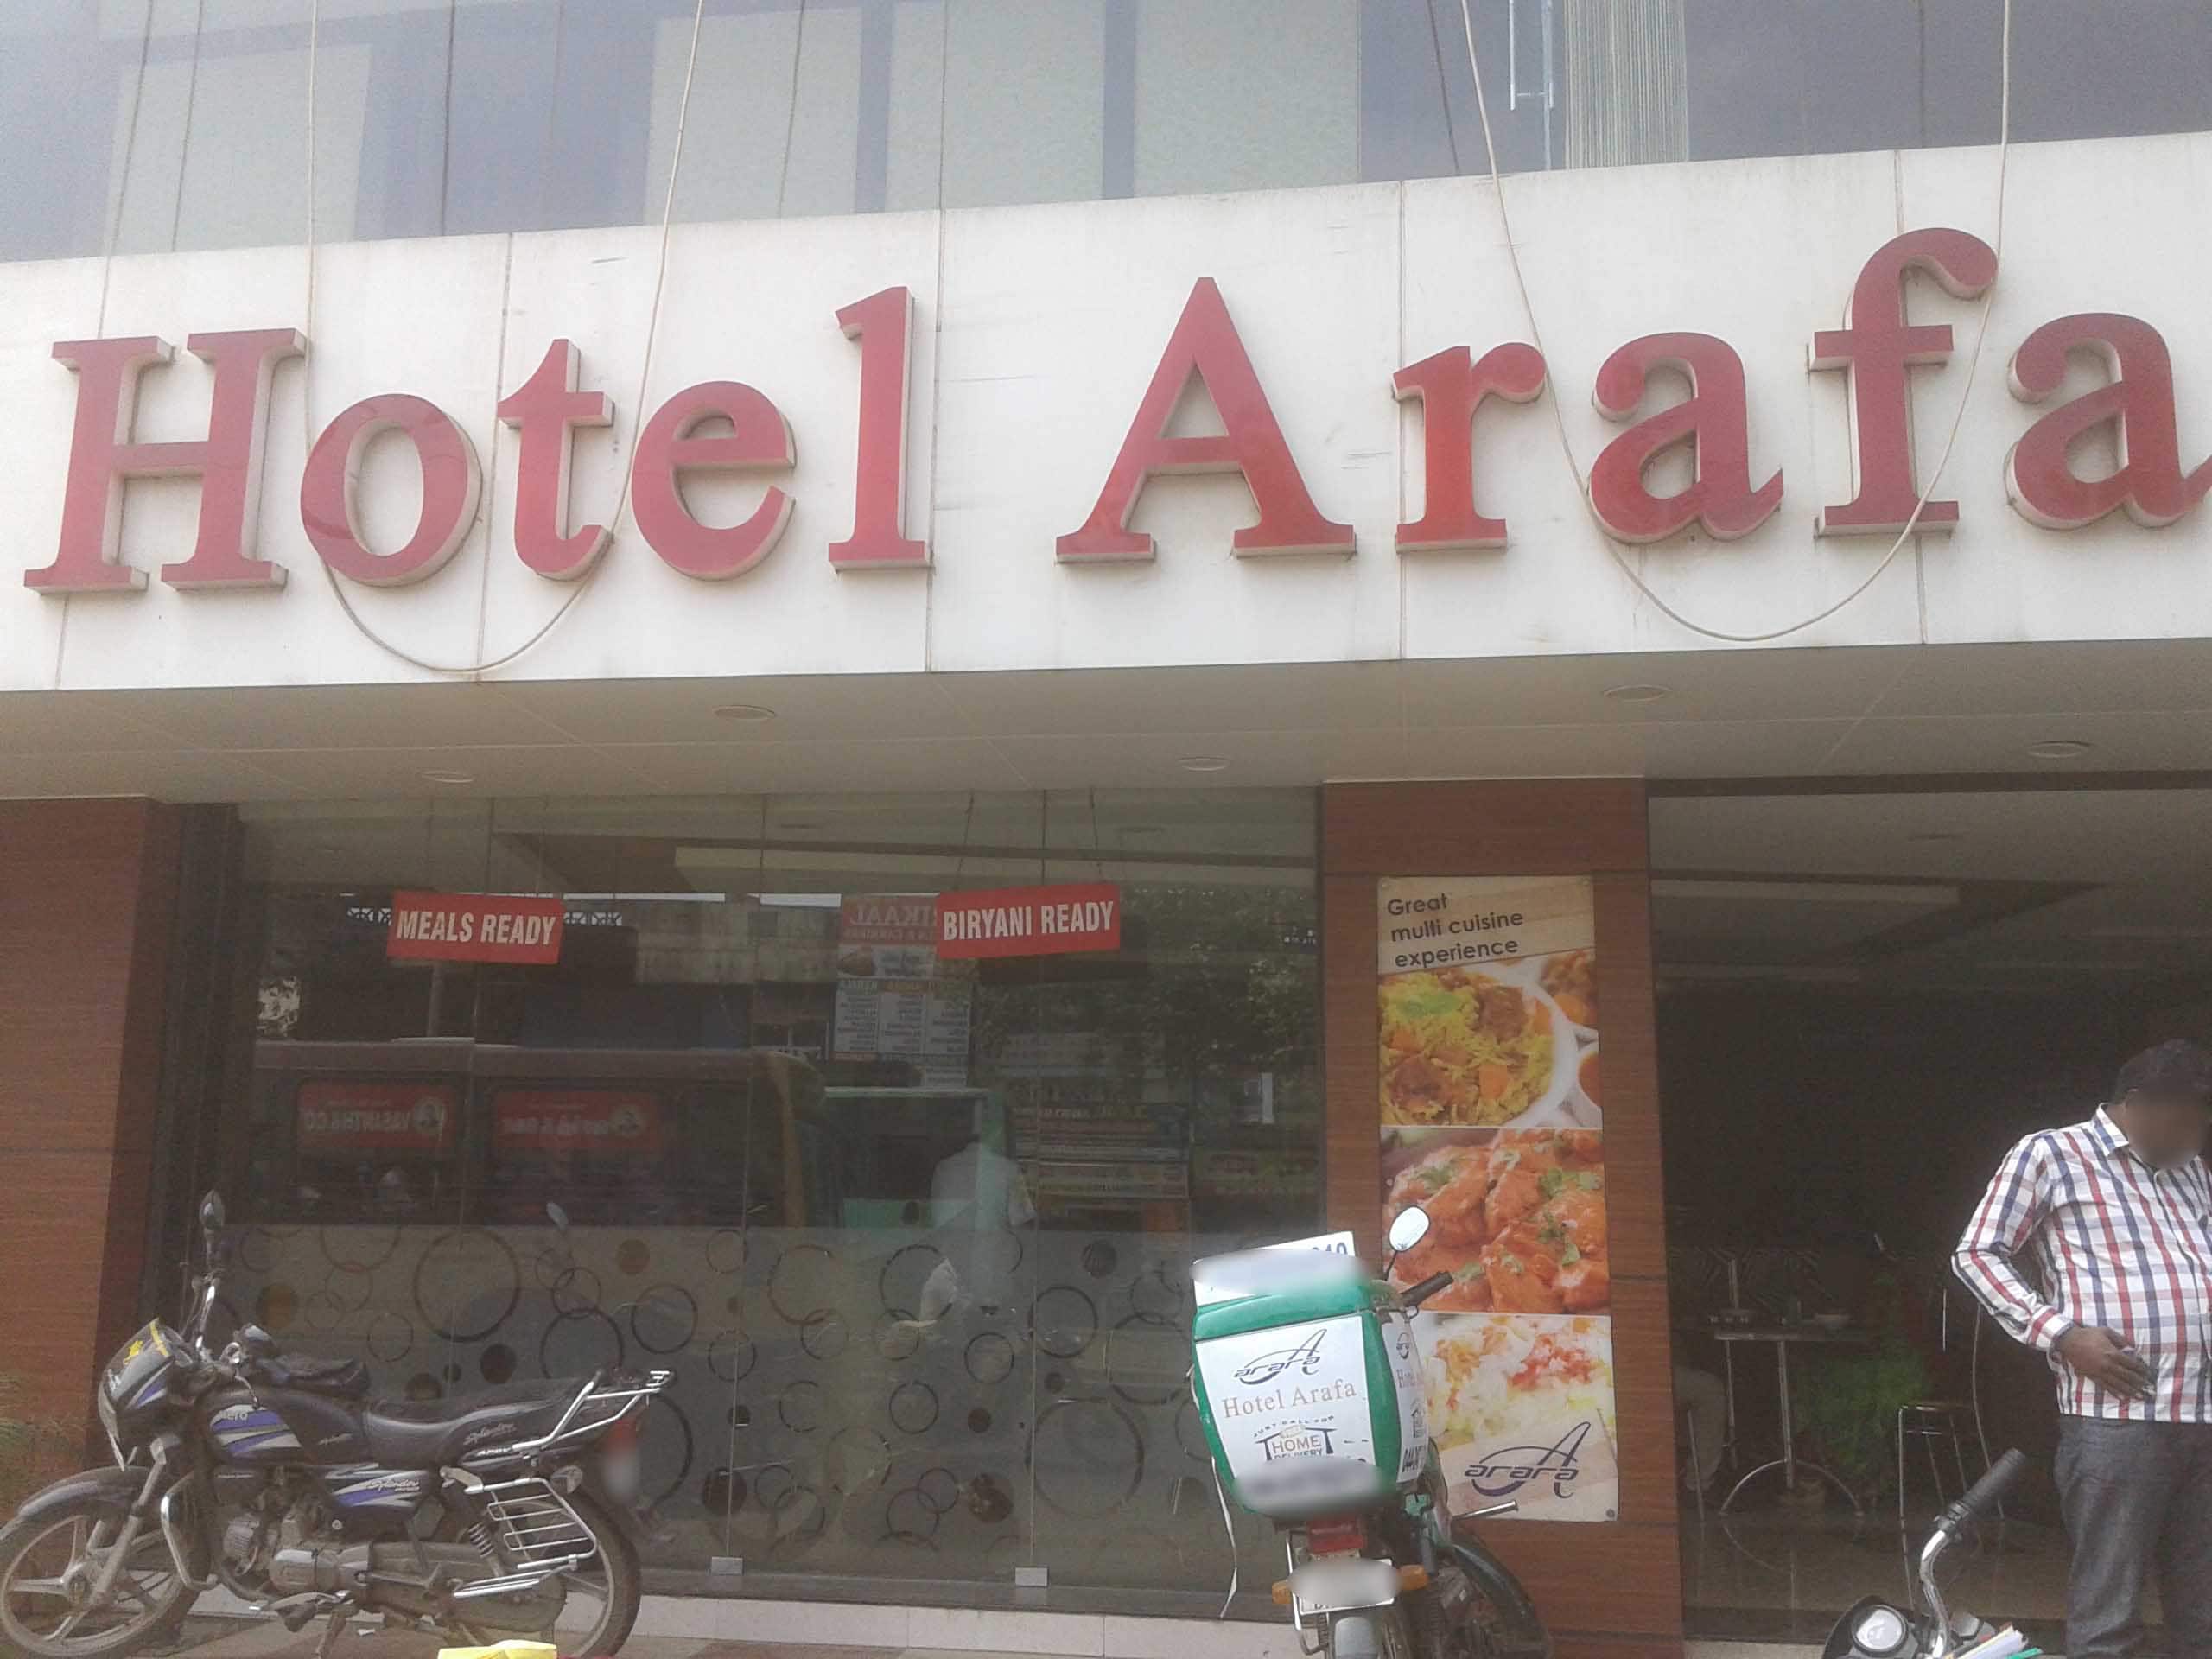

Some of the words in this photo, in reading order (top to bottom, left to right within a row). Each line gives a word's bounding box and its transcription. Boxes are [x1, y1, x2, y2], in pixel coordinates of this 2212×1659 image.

[23, 286, 931, 594] Hotel
[1055, 226, 2212, 563] Arafa
[943, 906, 1033, 941] BIRYANI
[1040, 900, 1114, 934] READY
[1387, 893, 1448, 916] Great
[396, 910, 474, 942] MEALS
[480, 913, 556, 945] READY
[1390, 919, 1443, 943] multi
[1447, 912, 1524, 934] cuisine
[1394, 939, 1519, 969] experience
[1222, 1389, 1285, 1419] Hotel
[1291, 1378, 1357, 1408] Arafa
[1272, 1434, 1322, 1454] HOME
